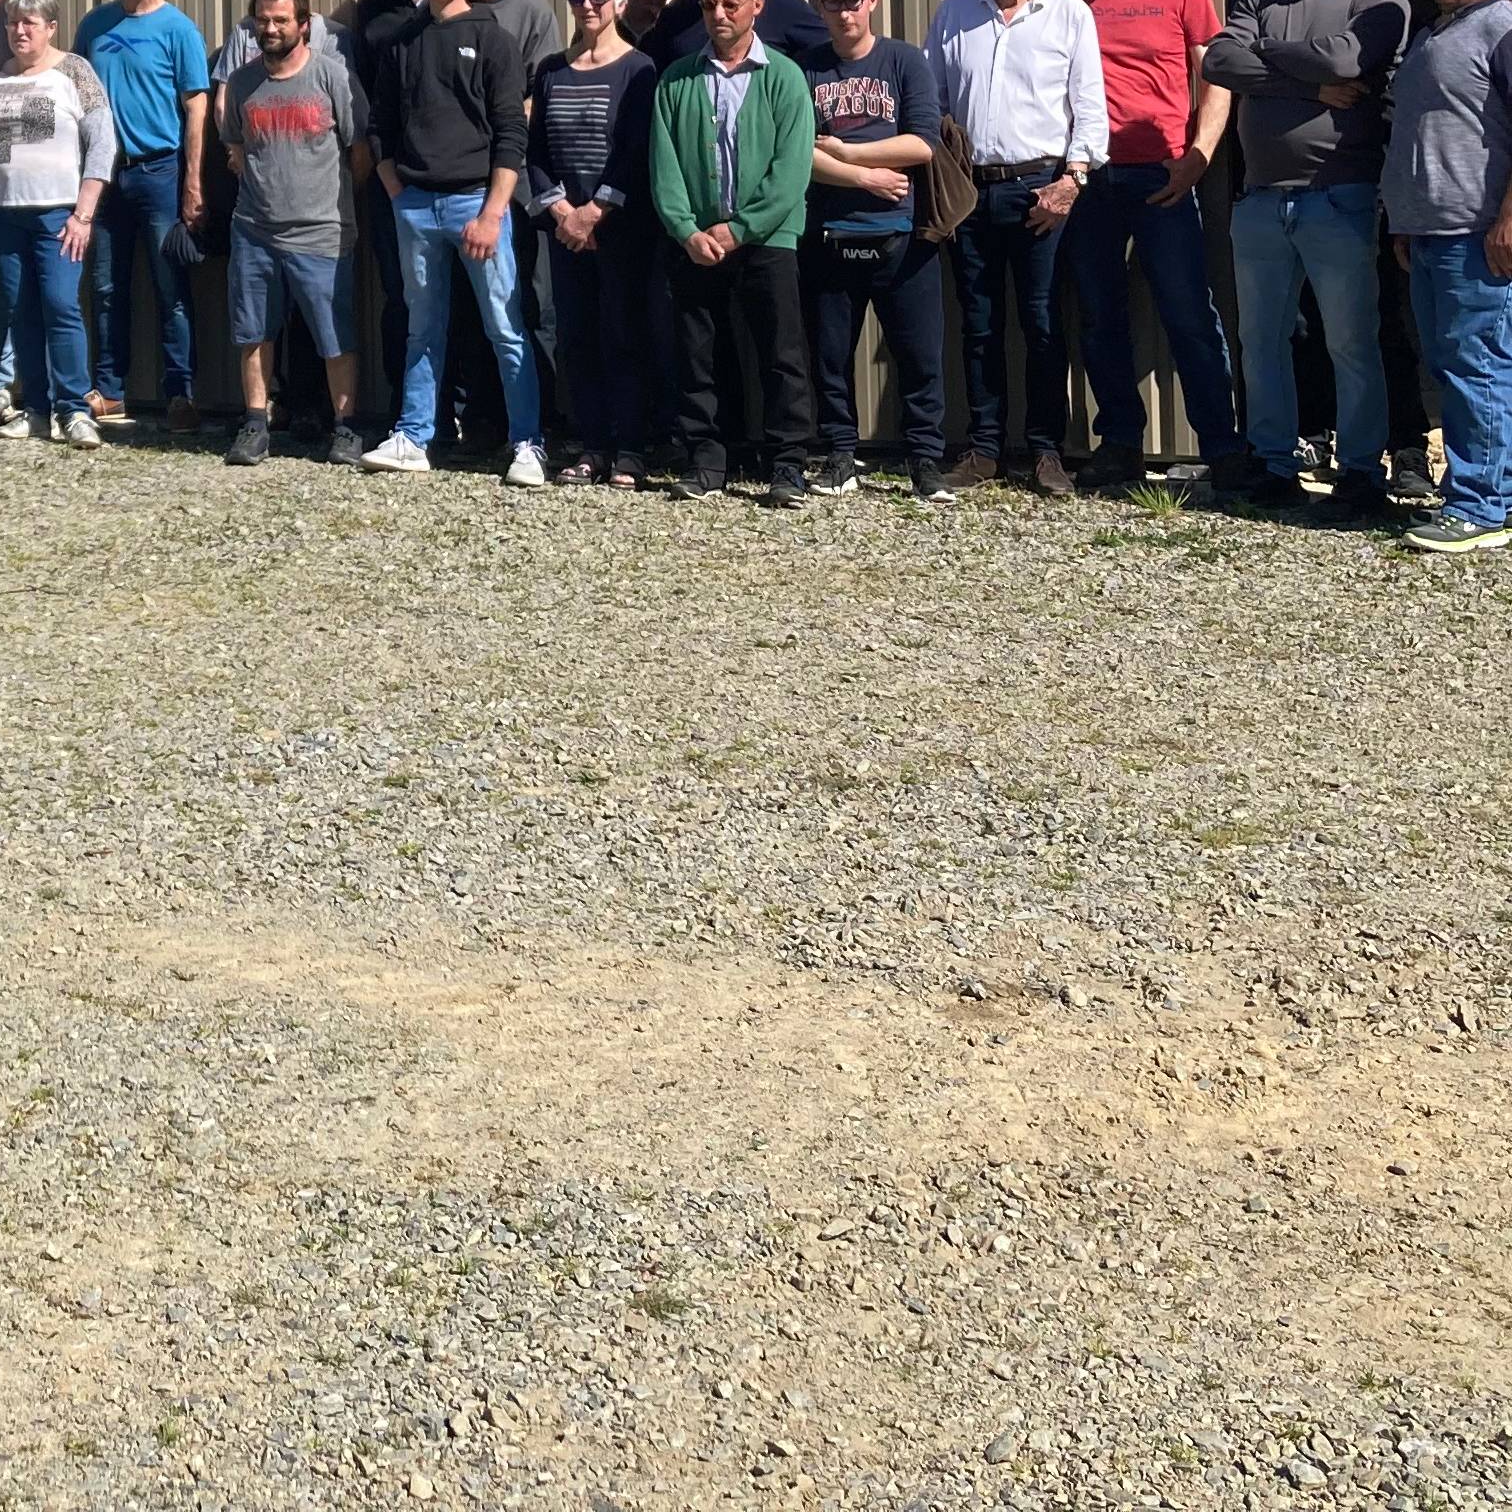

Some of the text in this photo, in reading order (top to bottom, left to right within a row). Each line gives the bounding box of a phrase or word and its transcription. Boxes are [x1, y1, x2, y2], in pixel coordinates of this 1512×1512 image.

[815, 77, 890, 106] RIGINAL
[821, 95, 895, 123] EAGUE
[843, 248, 880, 259] NASA
